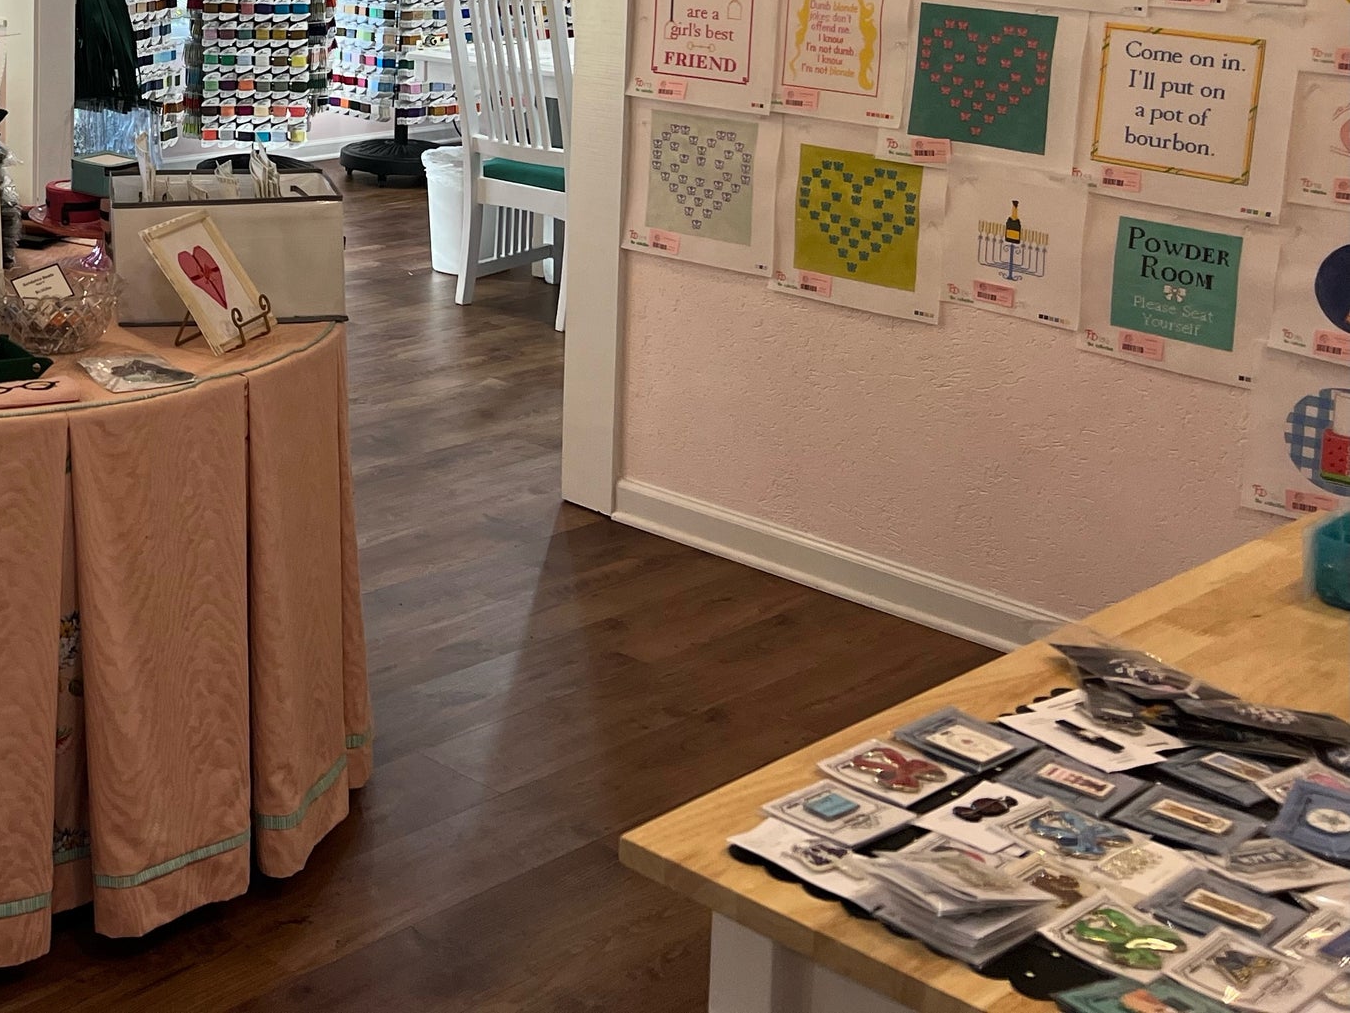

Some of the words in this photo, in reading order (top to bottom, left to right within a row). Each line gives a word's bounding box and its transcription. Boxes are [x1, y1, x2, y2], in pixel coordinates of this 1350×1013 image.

[687, 7, 708, 21] are
[712, 11, 720, 21] a
[810, 0, 831, 10] Dumb
[833, 1, 859, 13] blonde
[811, 20, 836, 33] offend
[832, 13, 852, 23] don't
[670, 22, 701, 40] girl's
[705, 24, 734, 41] best
[823, 33, 844, 44] know
[806, 41, 817, 52] I'm
[819, 45, 832, 54] not
[1125, 40, 1183, 63] Come
[1190, 54, 1215, 68] on
[1221, 53, 1246, 72] in.
[663, 50, 737, 73] FRIEND
[822, 54, 843, 65] know
[801, 62, 813, 72] I'm
[815, 66, 827, 75] not
[829, 67, 855, 77] blonde
[1128, 68, 1156, 91] I'll
[1159, 80, 1195, 98] put
[1200, 86, 1226, 100] on
[1135, 105, 1145, 118] a
[1149, 108, 1184, 126] pot
[1188, 108, 1211, 126] of
[1124, 126, 1215, 157] bourbon.
[1133, 294, 1177, 314] Please
[1182, 305, 1214, 324] Seat
[1142, 312, 1202, 337] Yourself
